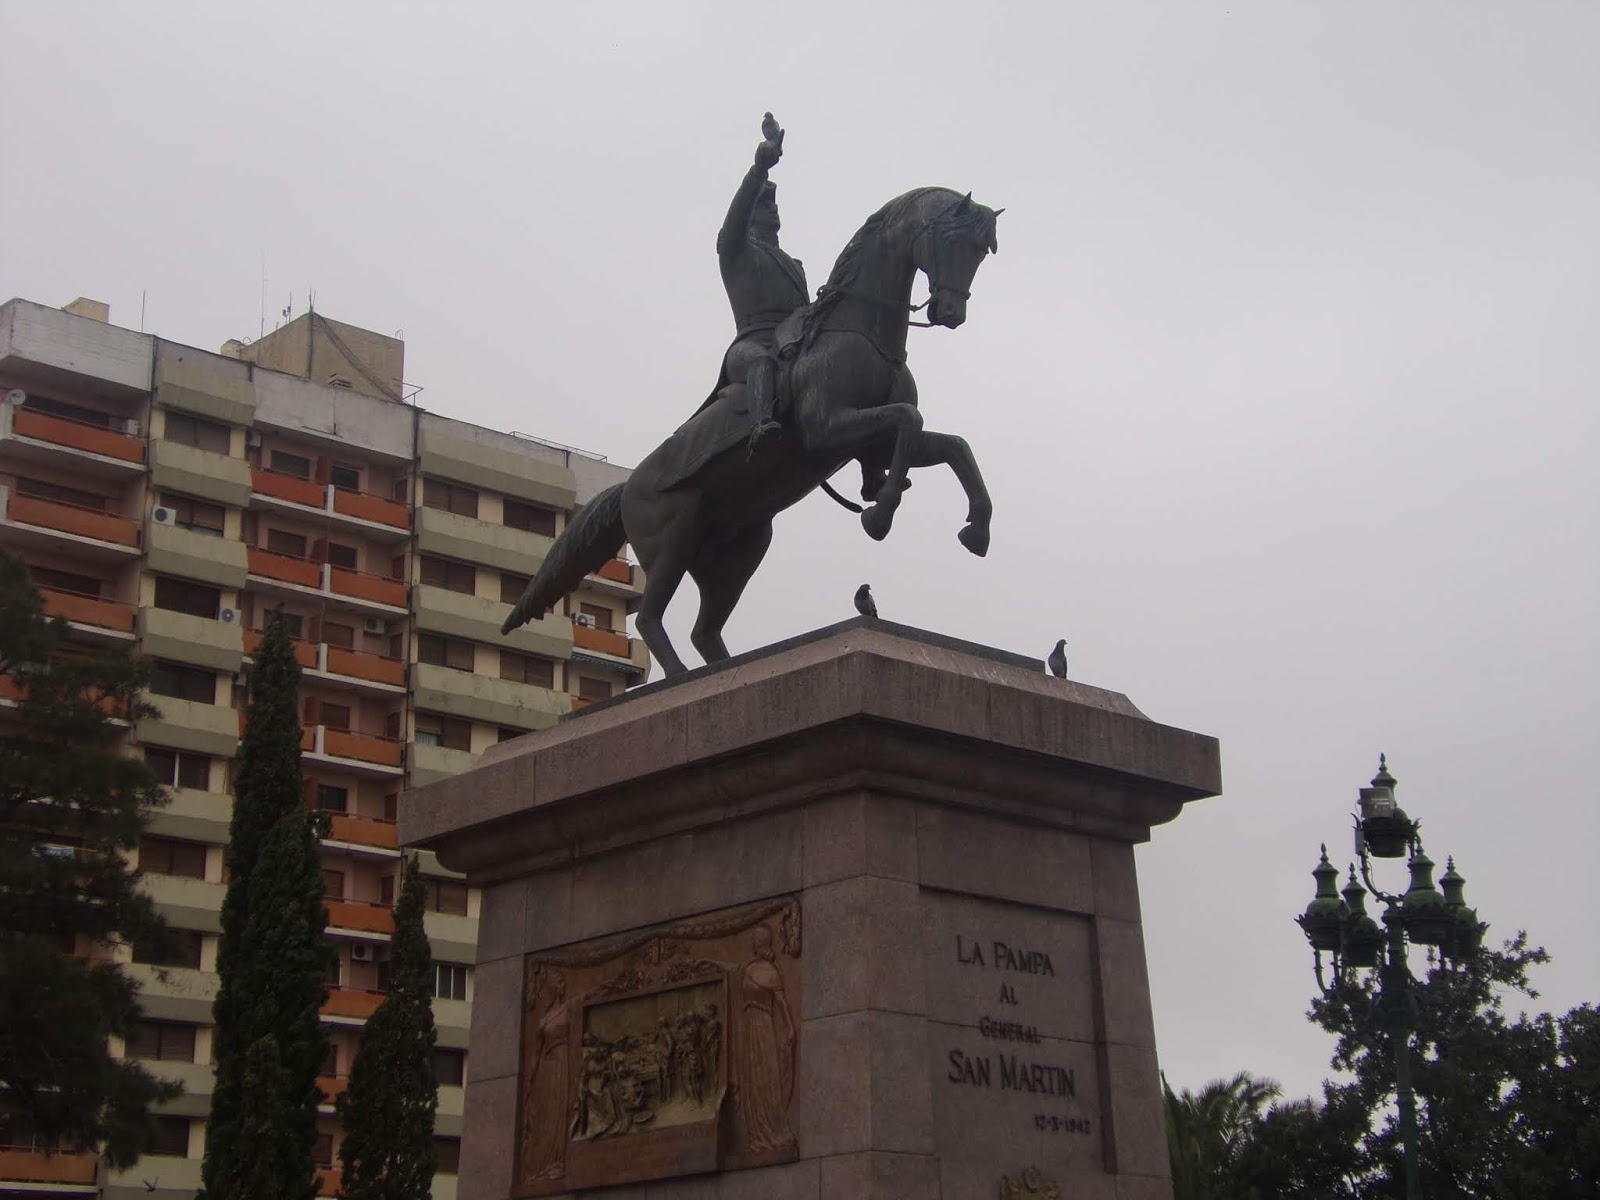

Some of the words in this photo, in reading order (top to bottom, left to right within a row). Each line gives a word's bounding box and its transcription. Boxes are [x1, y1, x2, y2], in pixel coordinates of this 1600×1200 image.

[956, 934, 985, 966] LA
[994, 942, 1055, 977] PAMPA
[1000, 983, 1019, 1006] AL
[979, 1015, 1041, 1044] GENERAL
[949, 1050, 990, 1087] SAN
[1000, 1054, 1076, 1097] MARTIN
